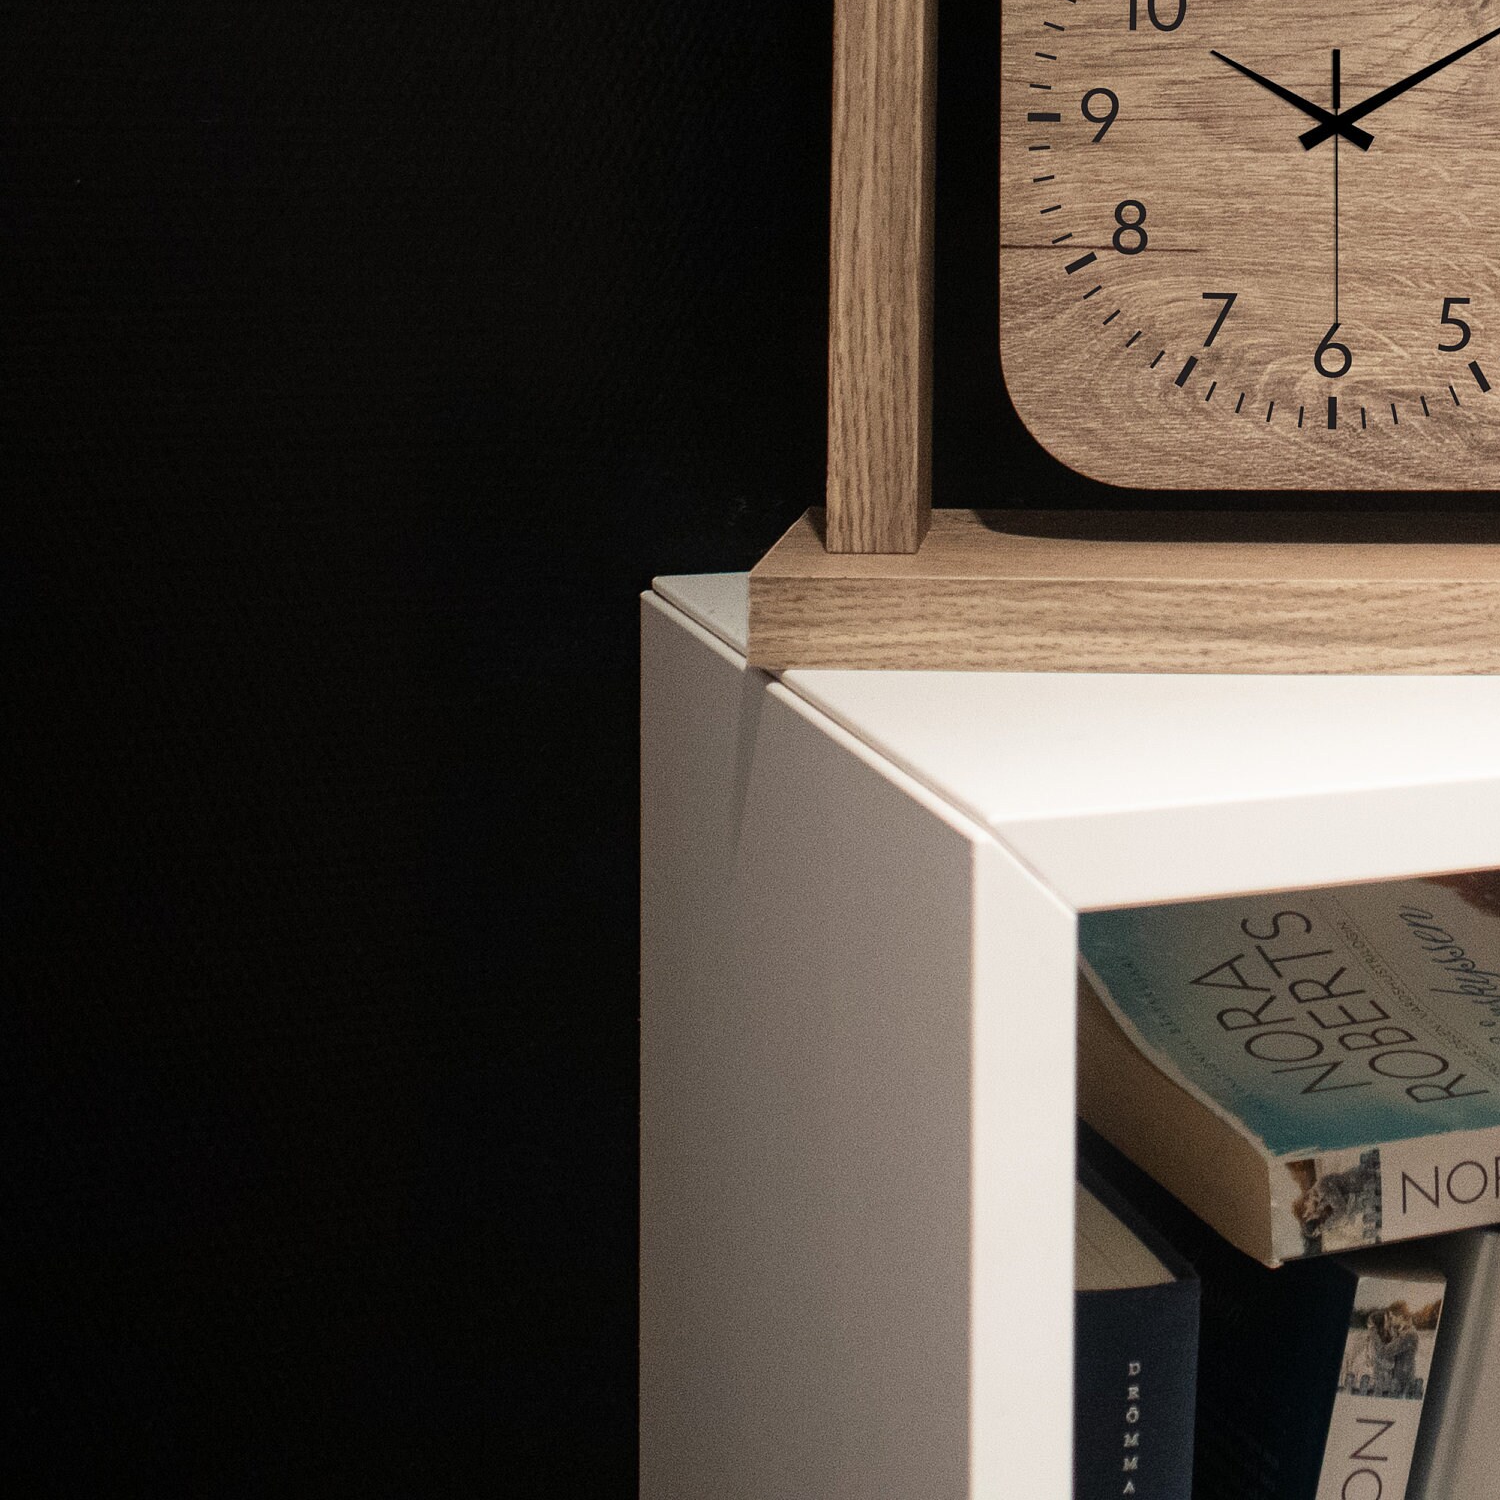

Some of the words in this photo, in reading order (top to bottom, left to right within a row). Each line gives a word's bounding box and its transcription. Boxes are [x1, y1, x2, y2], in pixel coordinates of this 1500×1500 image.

[1080, 87, 1120, 143] 9
[1111, 200, 1149, 255] 8
[1202, 292, 1238, 347] 7
[1437, 297, 1472, 352] 5
[1313, 322, 1353, 378] 6
[1189, 952, 1372, 1096] NORA
[1240, 910, 1490, 1104] ROBERTS
